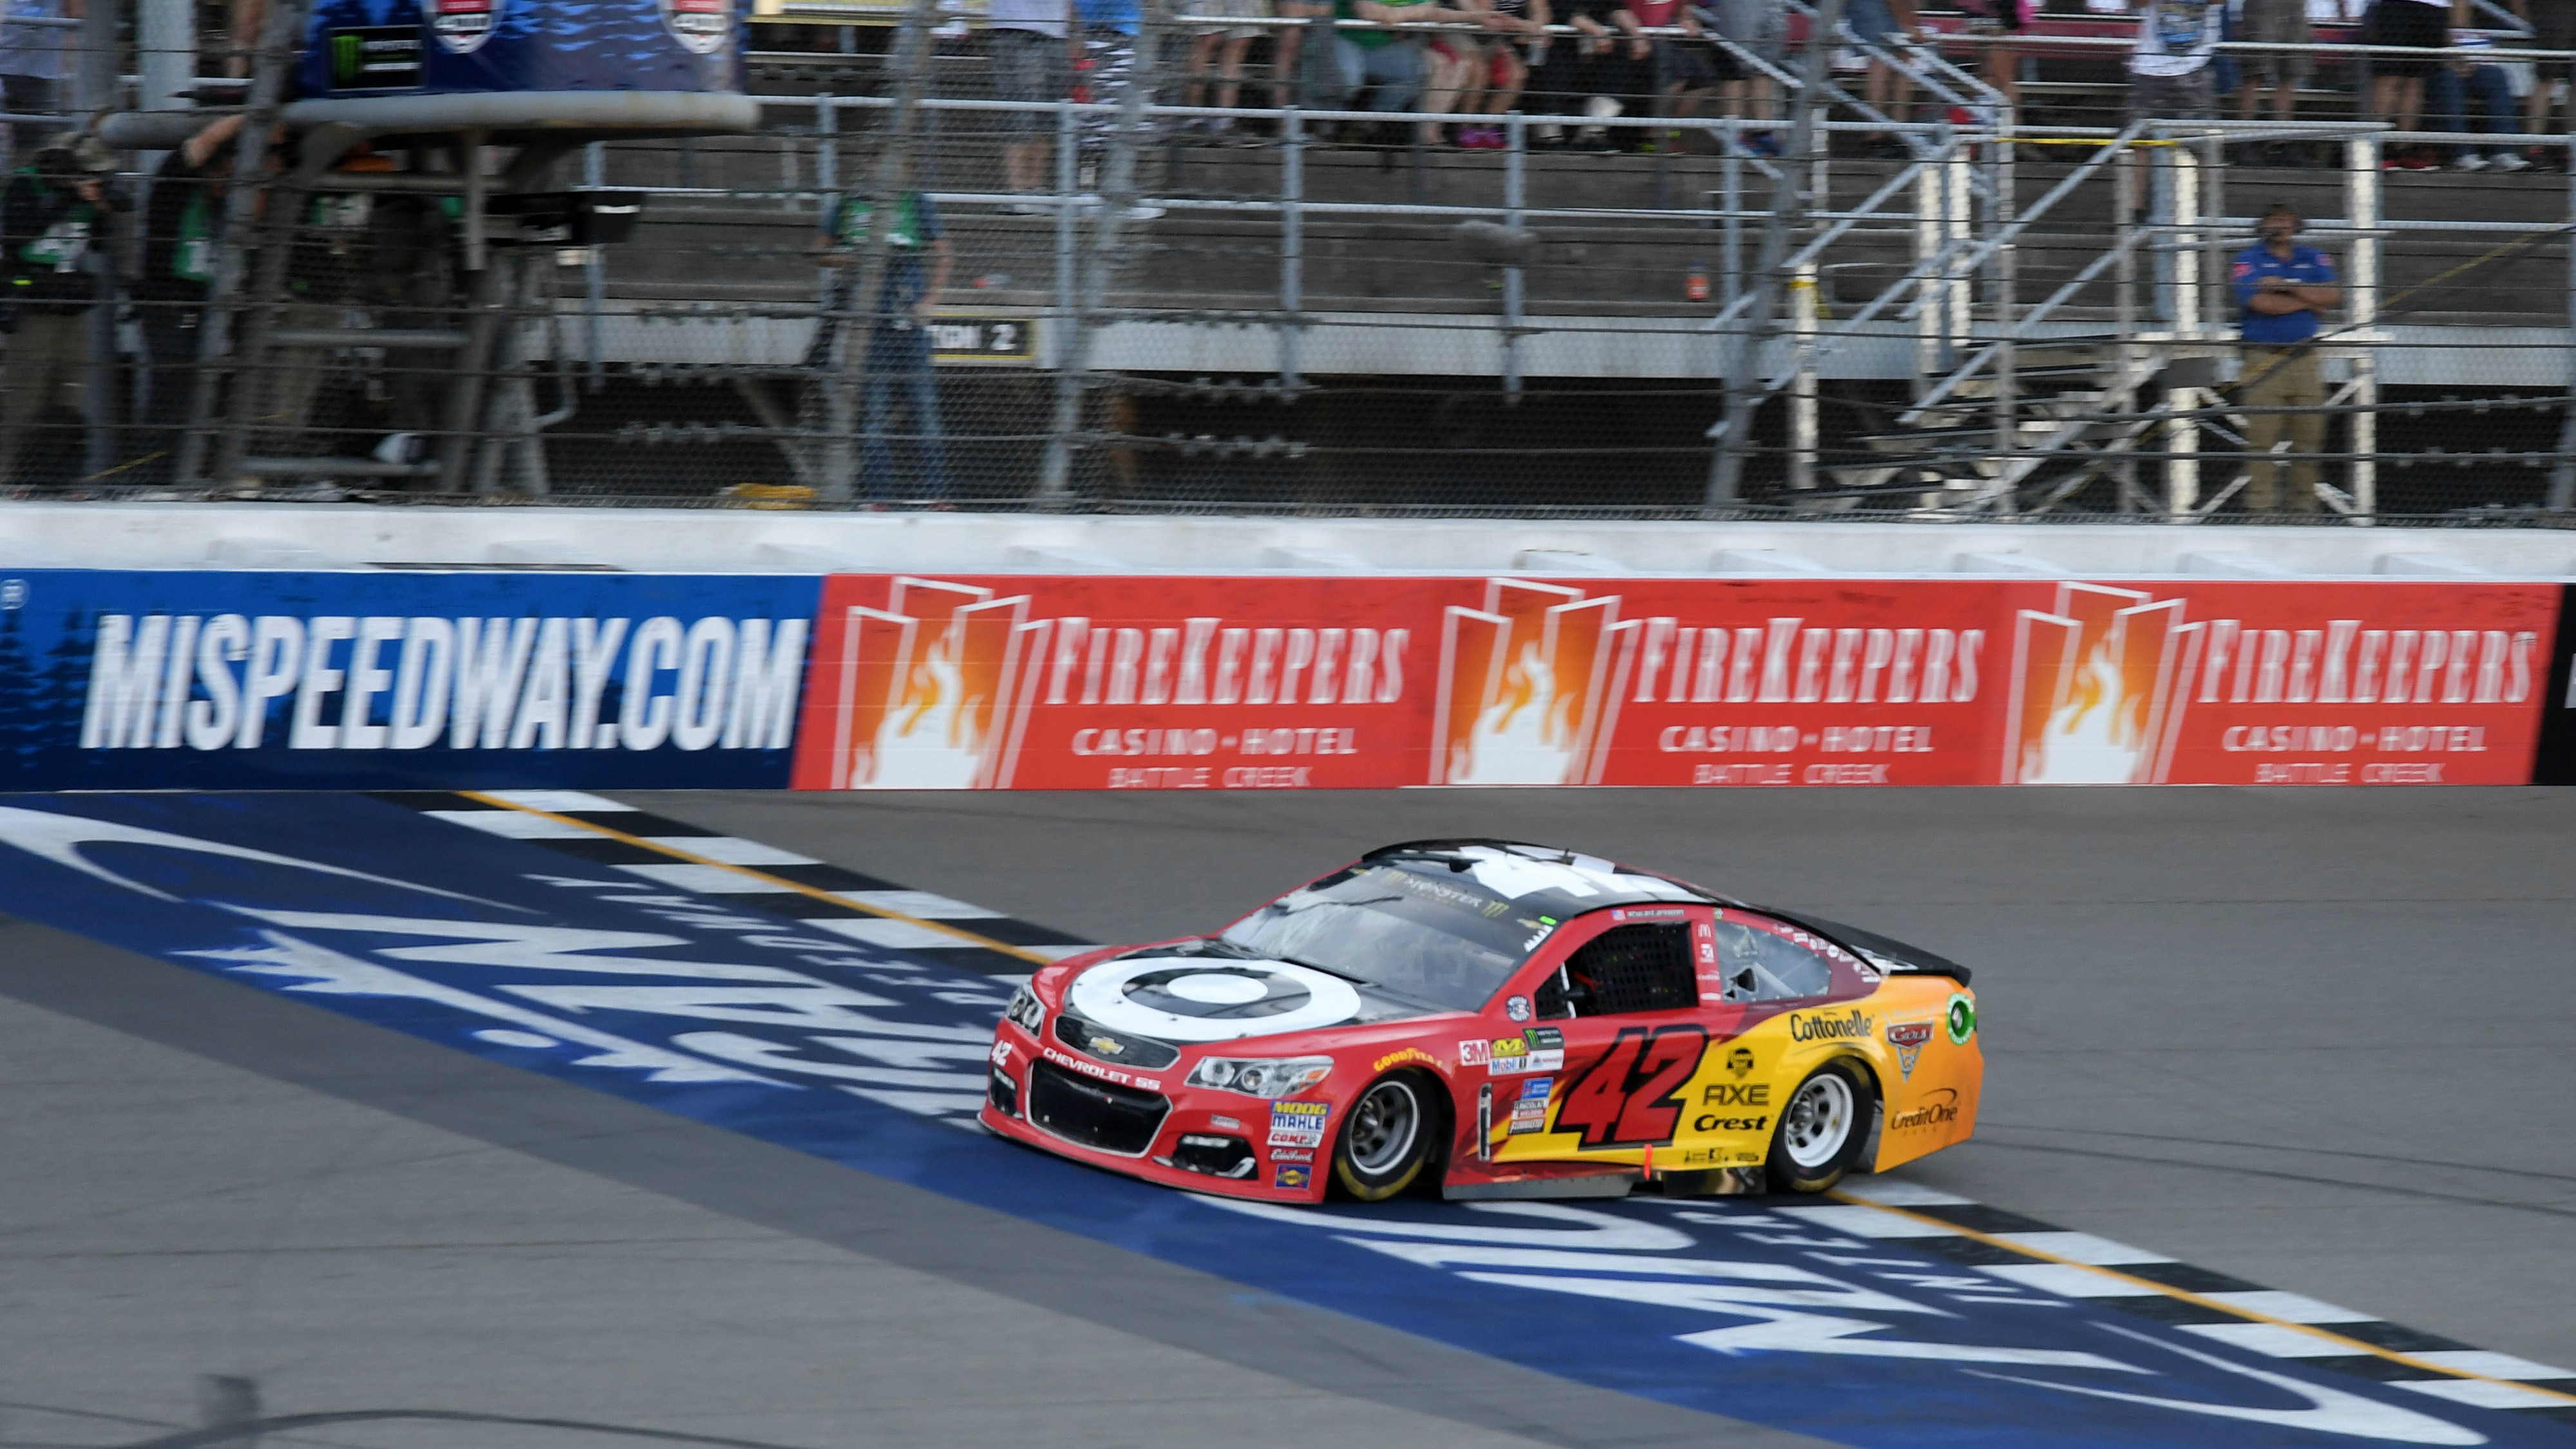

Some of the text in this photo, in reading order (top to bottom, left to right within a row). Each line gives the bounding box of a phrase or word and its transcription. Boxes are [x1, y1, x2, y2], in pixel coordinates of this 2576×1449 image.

[990, 324, 1018, 351] 2
[79, 614, 810, 752] MISPEEDWAY.COM
[1790, 1009, 1873, 1043] Cottonelle
[991, 1039, 1012, 1067] 42
[1463, 1043, 1488, 1063] 3M
[1043, 1046, 1161, 1090] CHEVROLET SS
[1550, 1023, 1710, 1151] 42
[1702, 1083, 1770, 1106] AXE
[1273, 1101, 1329, 1115] MOOG
[1272, 1115, 1322, 1130] MAHLE
[1694, 1114, 1768, 1132] Crest
[1271, 1133, 1307, 1142] COMP
